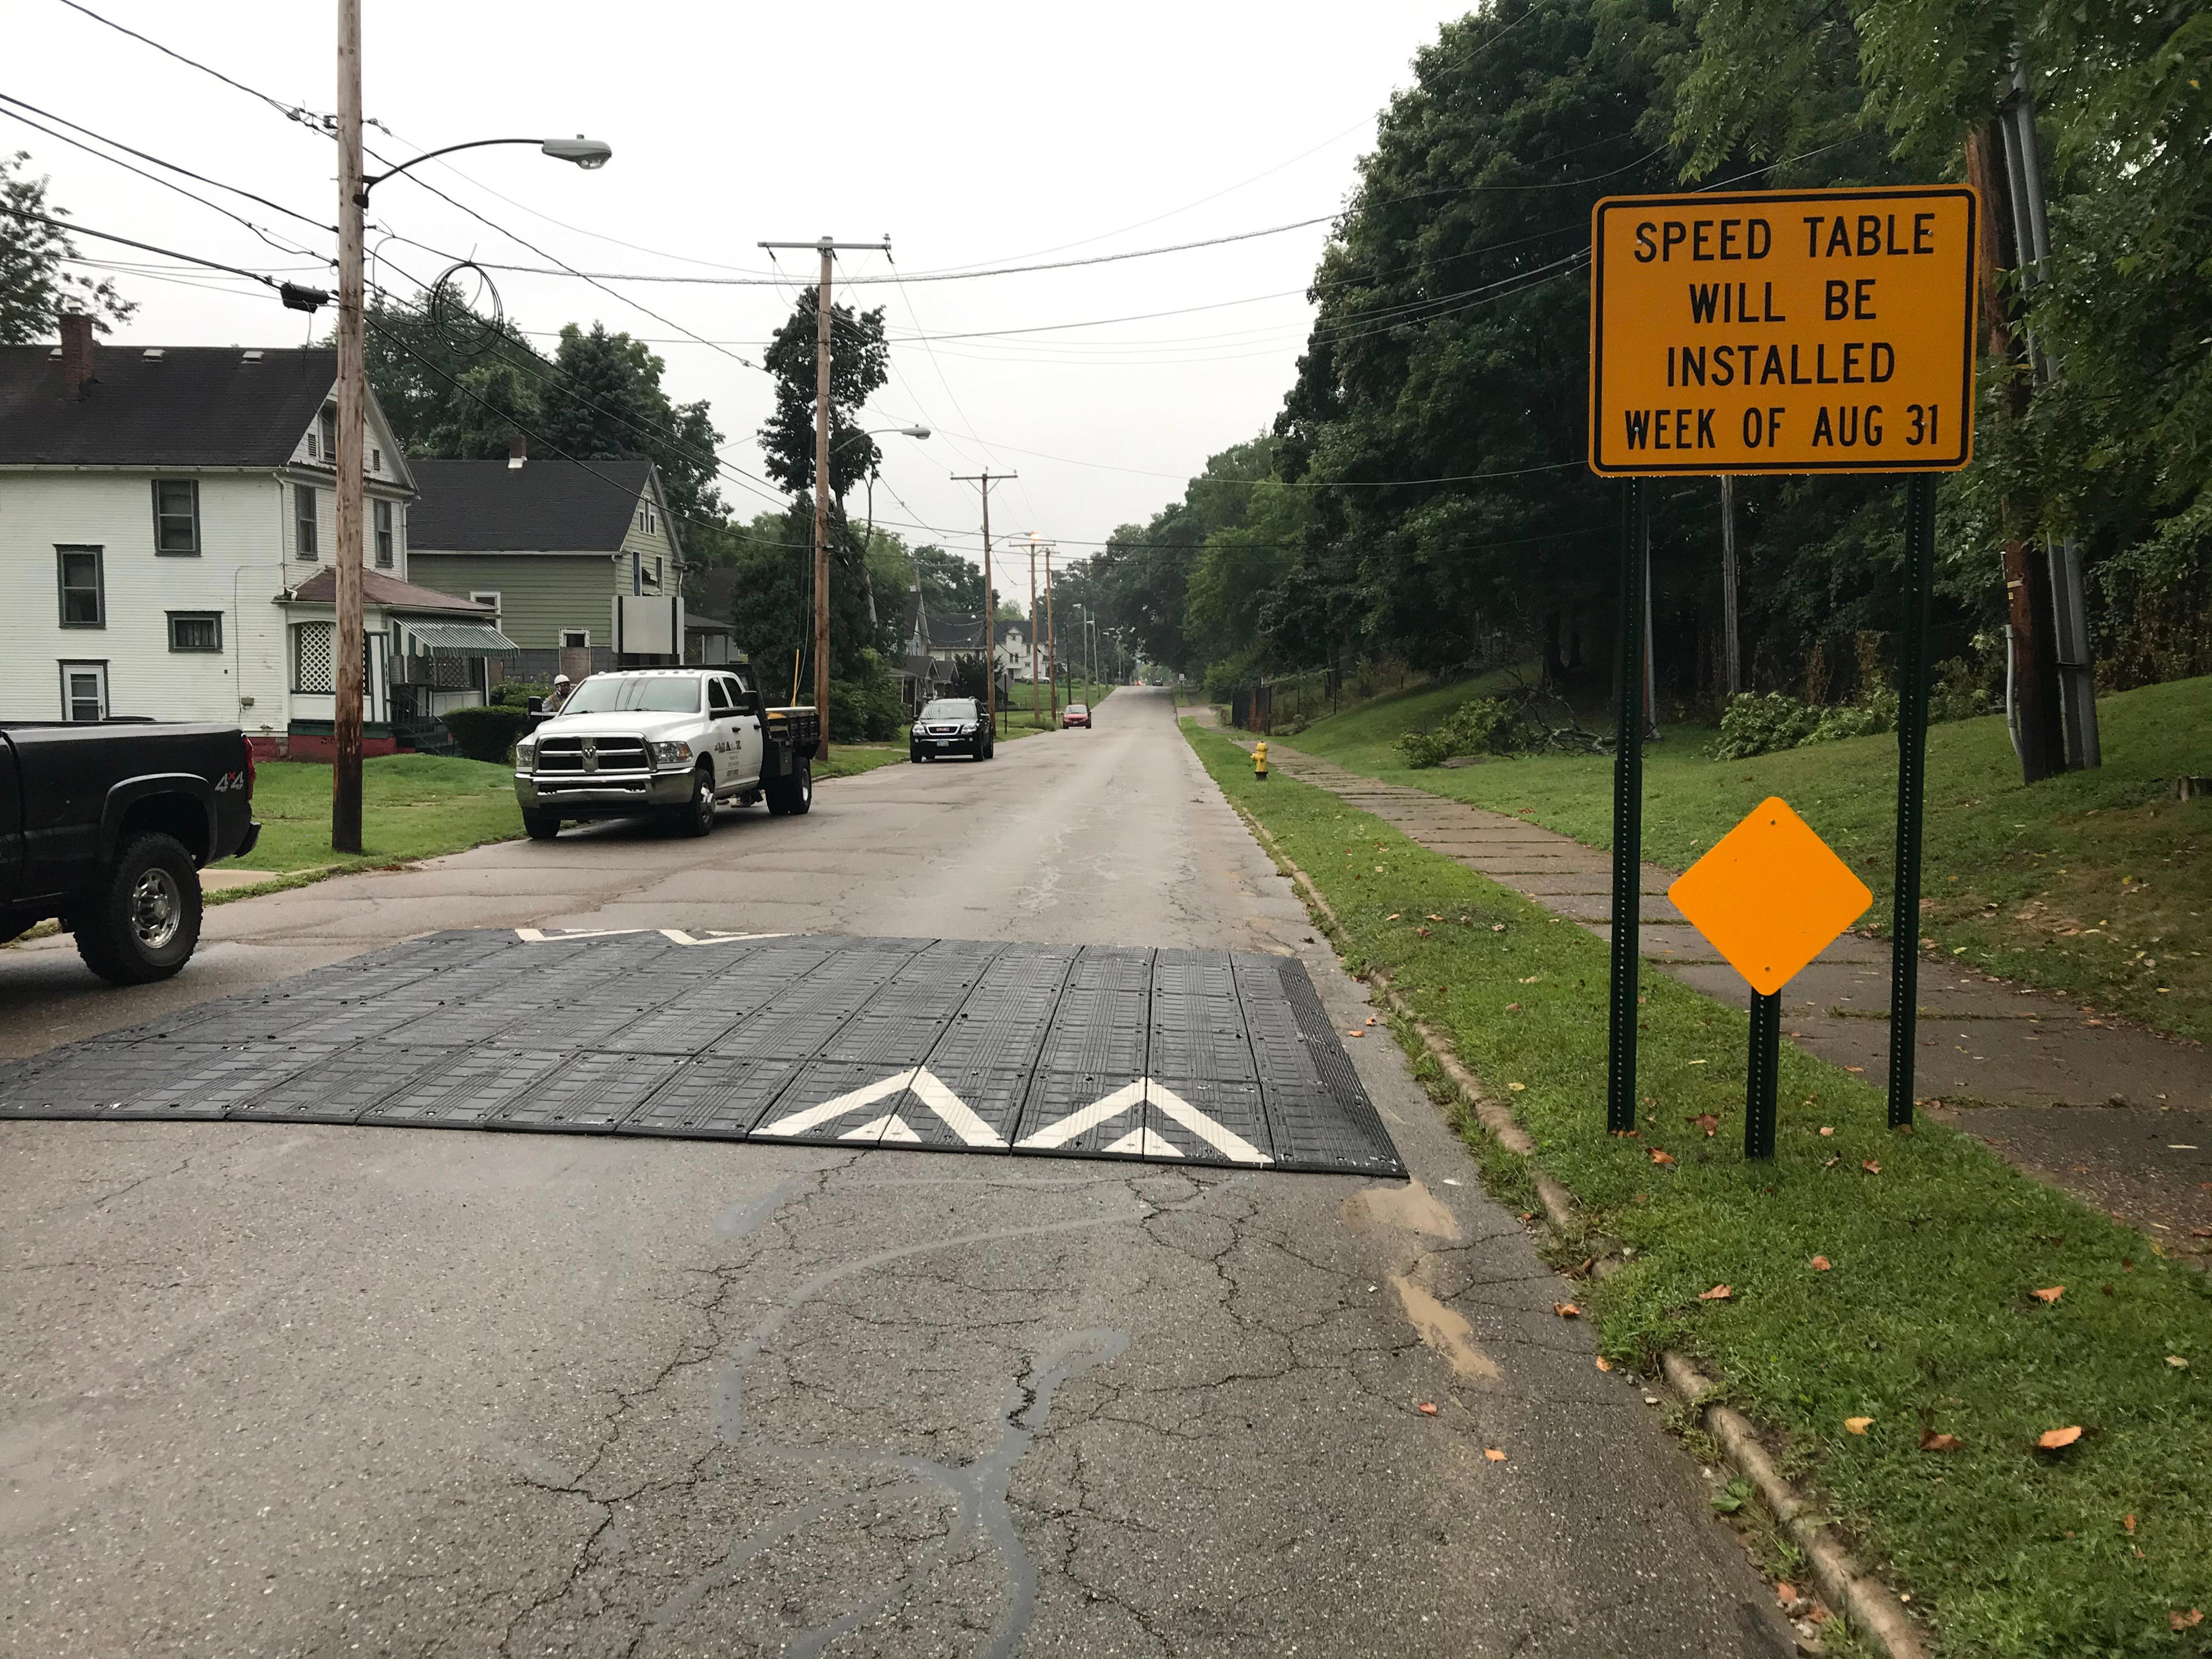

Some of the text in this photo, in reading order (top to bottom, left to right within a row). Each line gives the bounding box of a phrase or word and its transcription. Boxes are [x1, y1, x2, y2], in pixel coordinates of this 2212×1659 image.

[1634, 213, 1935, 262] SPEED TABLE
[1689, 279, 1877, 324] WILL BE
[1668, 342, 1895, 387] INSTALLED
[1625, 404, 1938, 450] WEEK OF AUG 31
